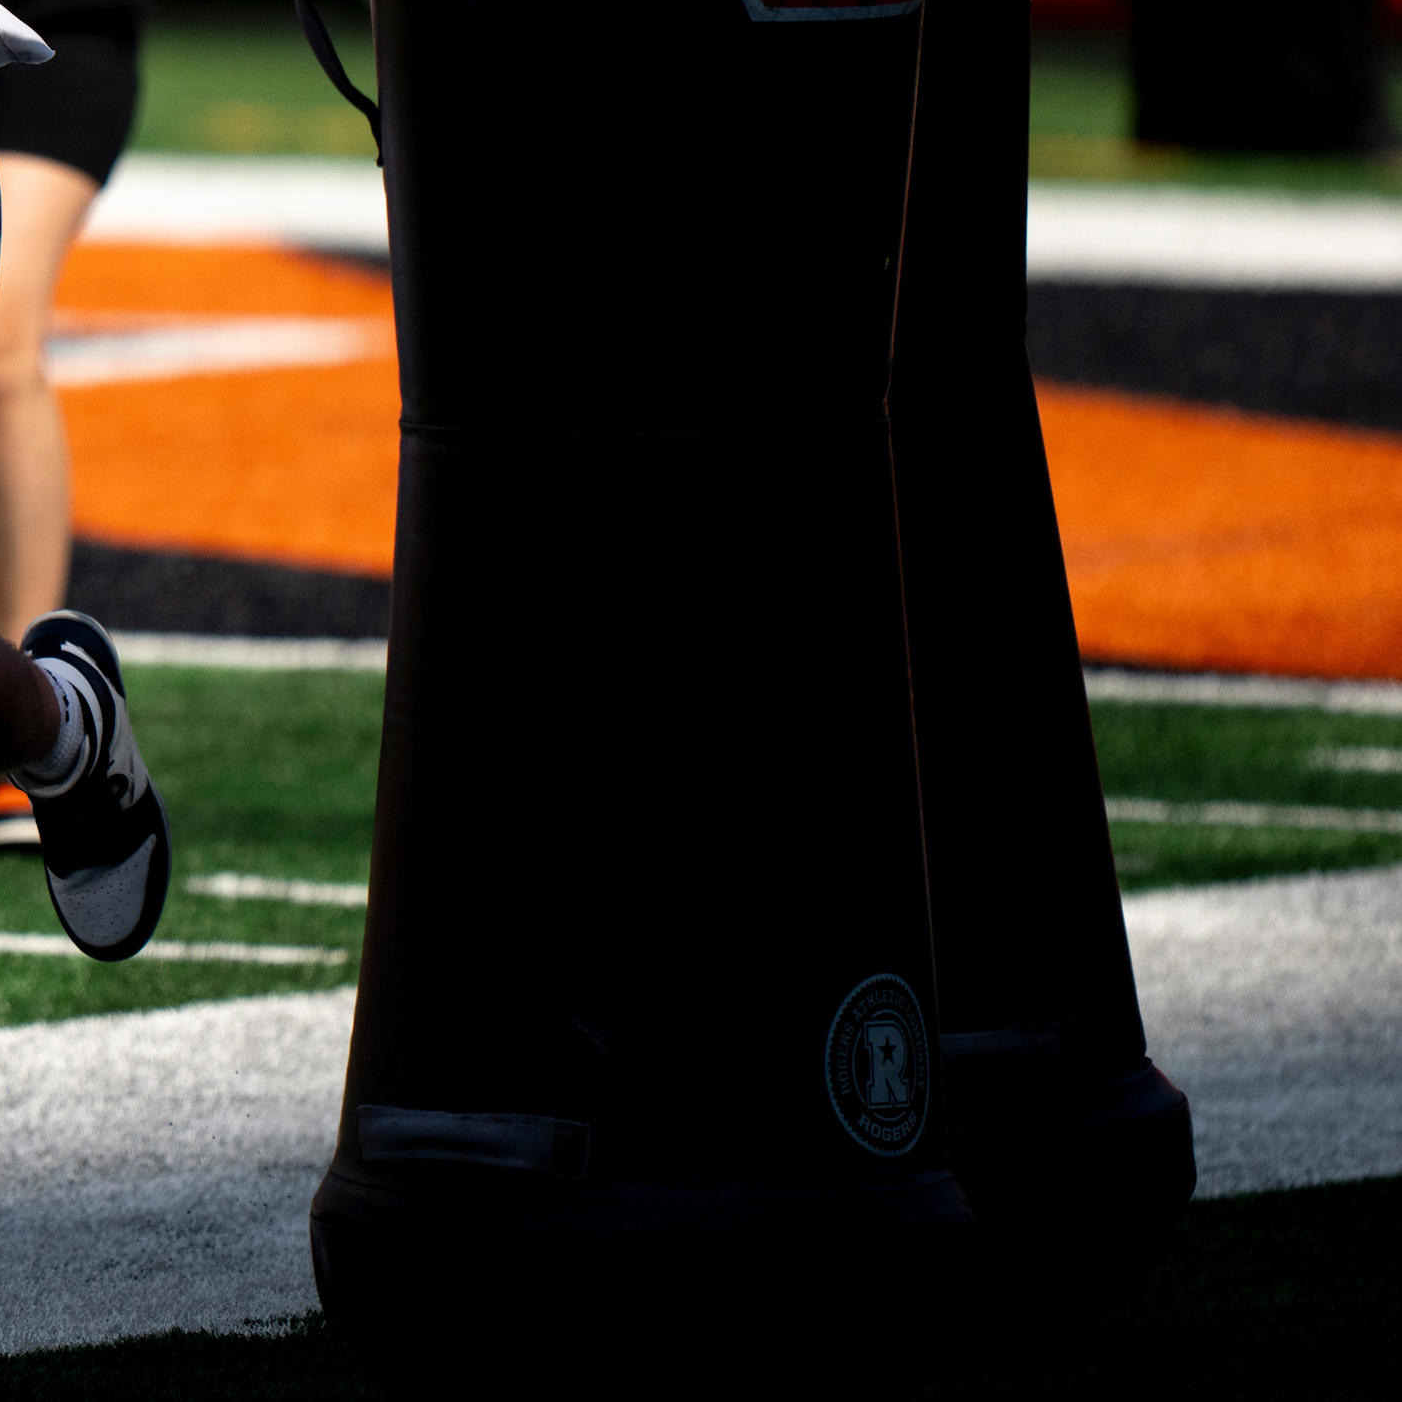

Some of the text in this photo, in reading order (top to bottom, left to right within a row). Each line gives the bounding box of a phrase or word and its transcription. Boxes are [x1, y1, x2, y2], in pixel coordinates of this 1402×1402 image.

[836, 1021, 856, 1096] ROGERS
[852, 989, 906, 1023] ATHLETIC
[863, 1019, 911, 1110] R
[857, 1110, 917, 1142] ROGERS
